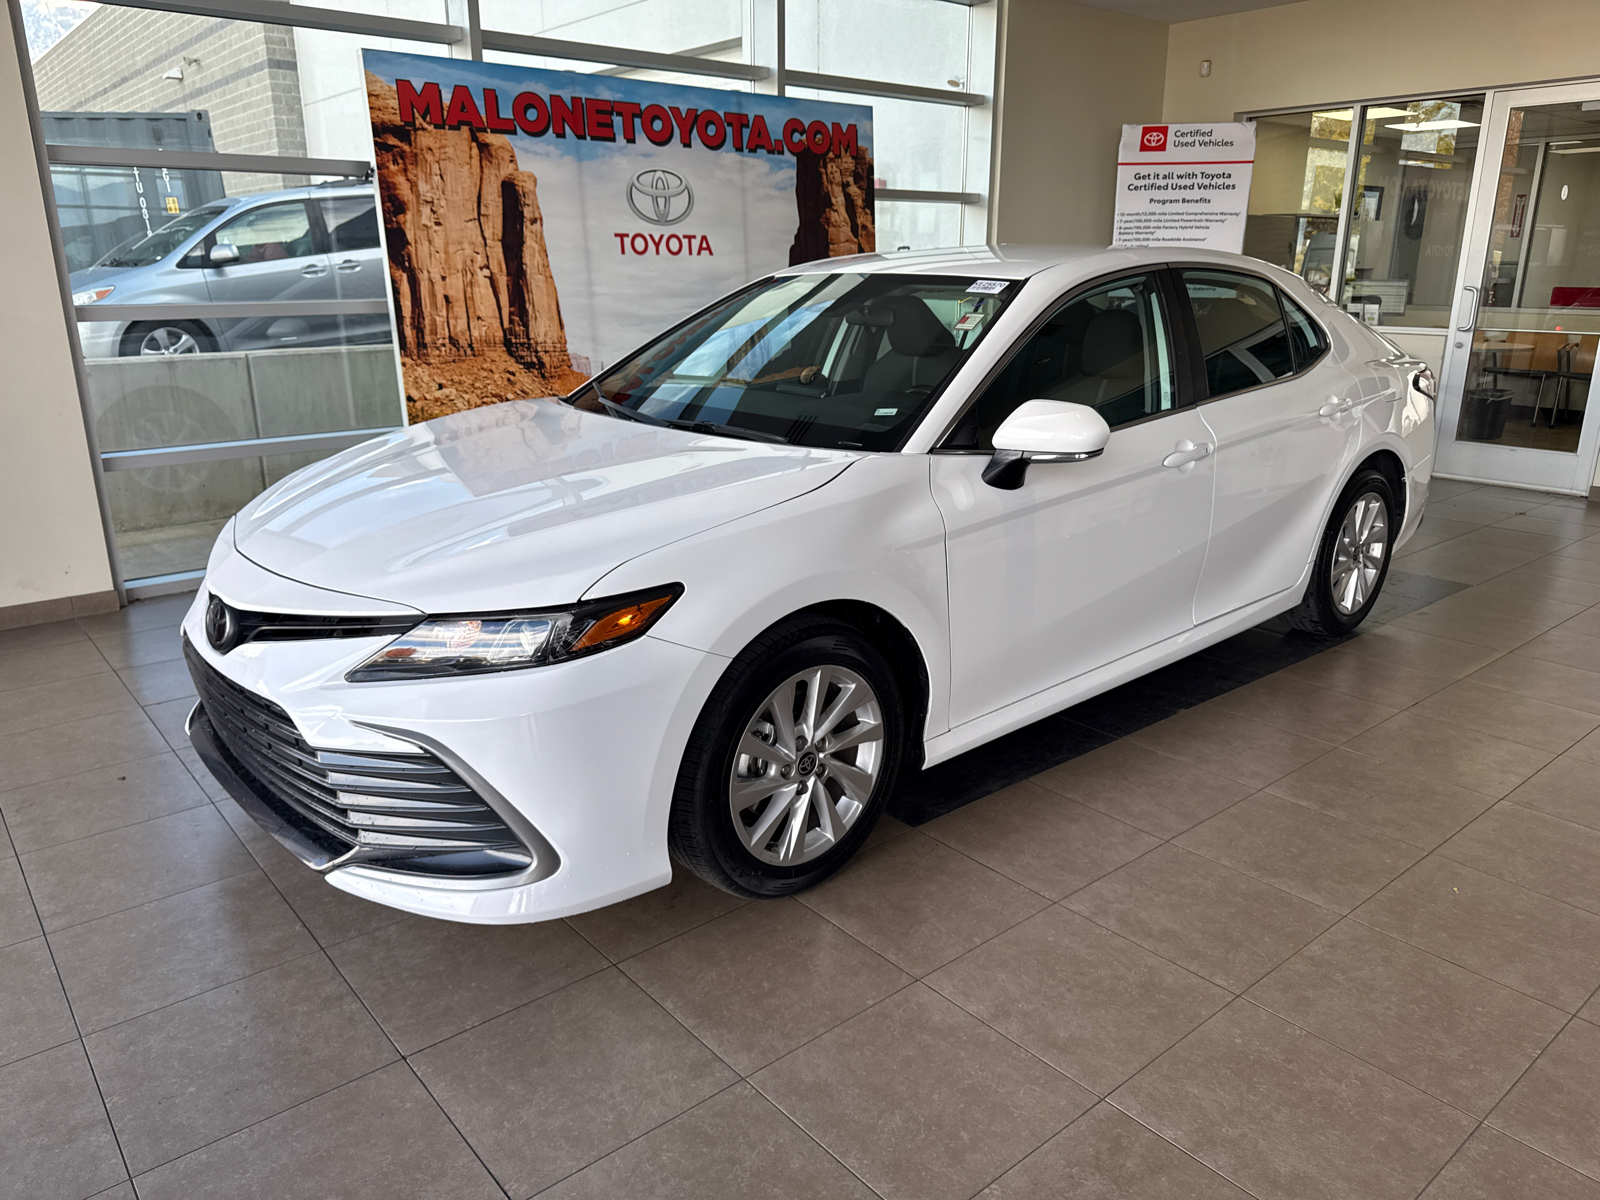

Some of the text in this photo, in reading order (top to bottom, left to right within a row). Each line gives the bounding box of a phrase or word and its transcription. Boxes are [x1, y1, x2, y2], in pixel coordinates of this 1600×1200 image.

[395, 79, 859, 158] MALONETOYOTA.COM
[1198, 139, 1234, 147] Vehicles
[1153, 172, 1160, 180] it
[1162, 172, 1174, 180] all
[1200, 171, 1231, 181] Toyota
[1128, 183, 1168, 191] Certified
[1197, 182, 1236, 190] Vehicles
[614, 232, 714, 256] TOYOTA
